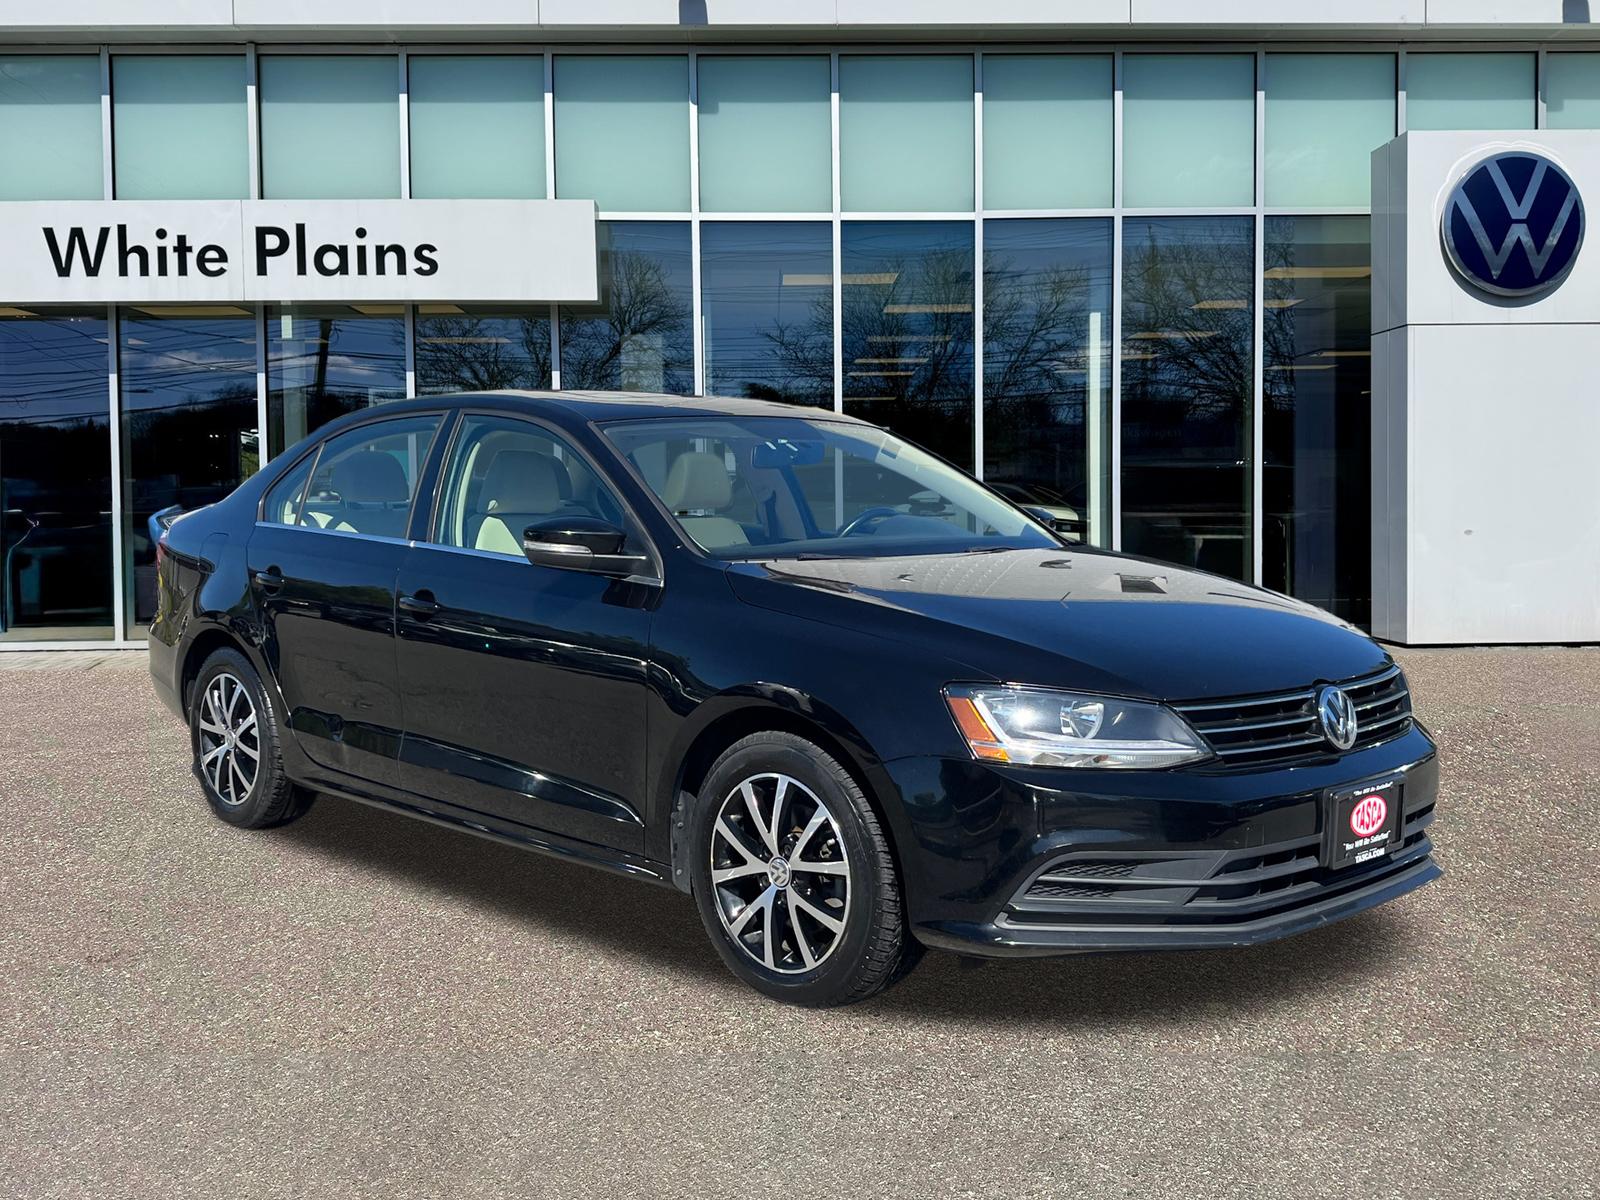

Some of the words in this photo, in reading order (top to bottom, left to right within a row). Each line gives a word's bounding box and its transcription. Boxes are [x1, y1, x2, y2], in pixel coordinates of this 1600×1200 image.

[42, 223, 229, 277] White
[255, 223, 438, 277] Plains
[1355, 800, 1382, 830] TASCA
